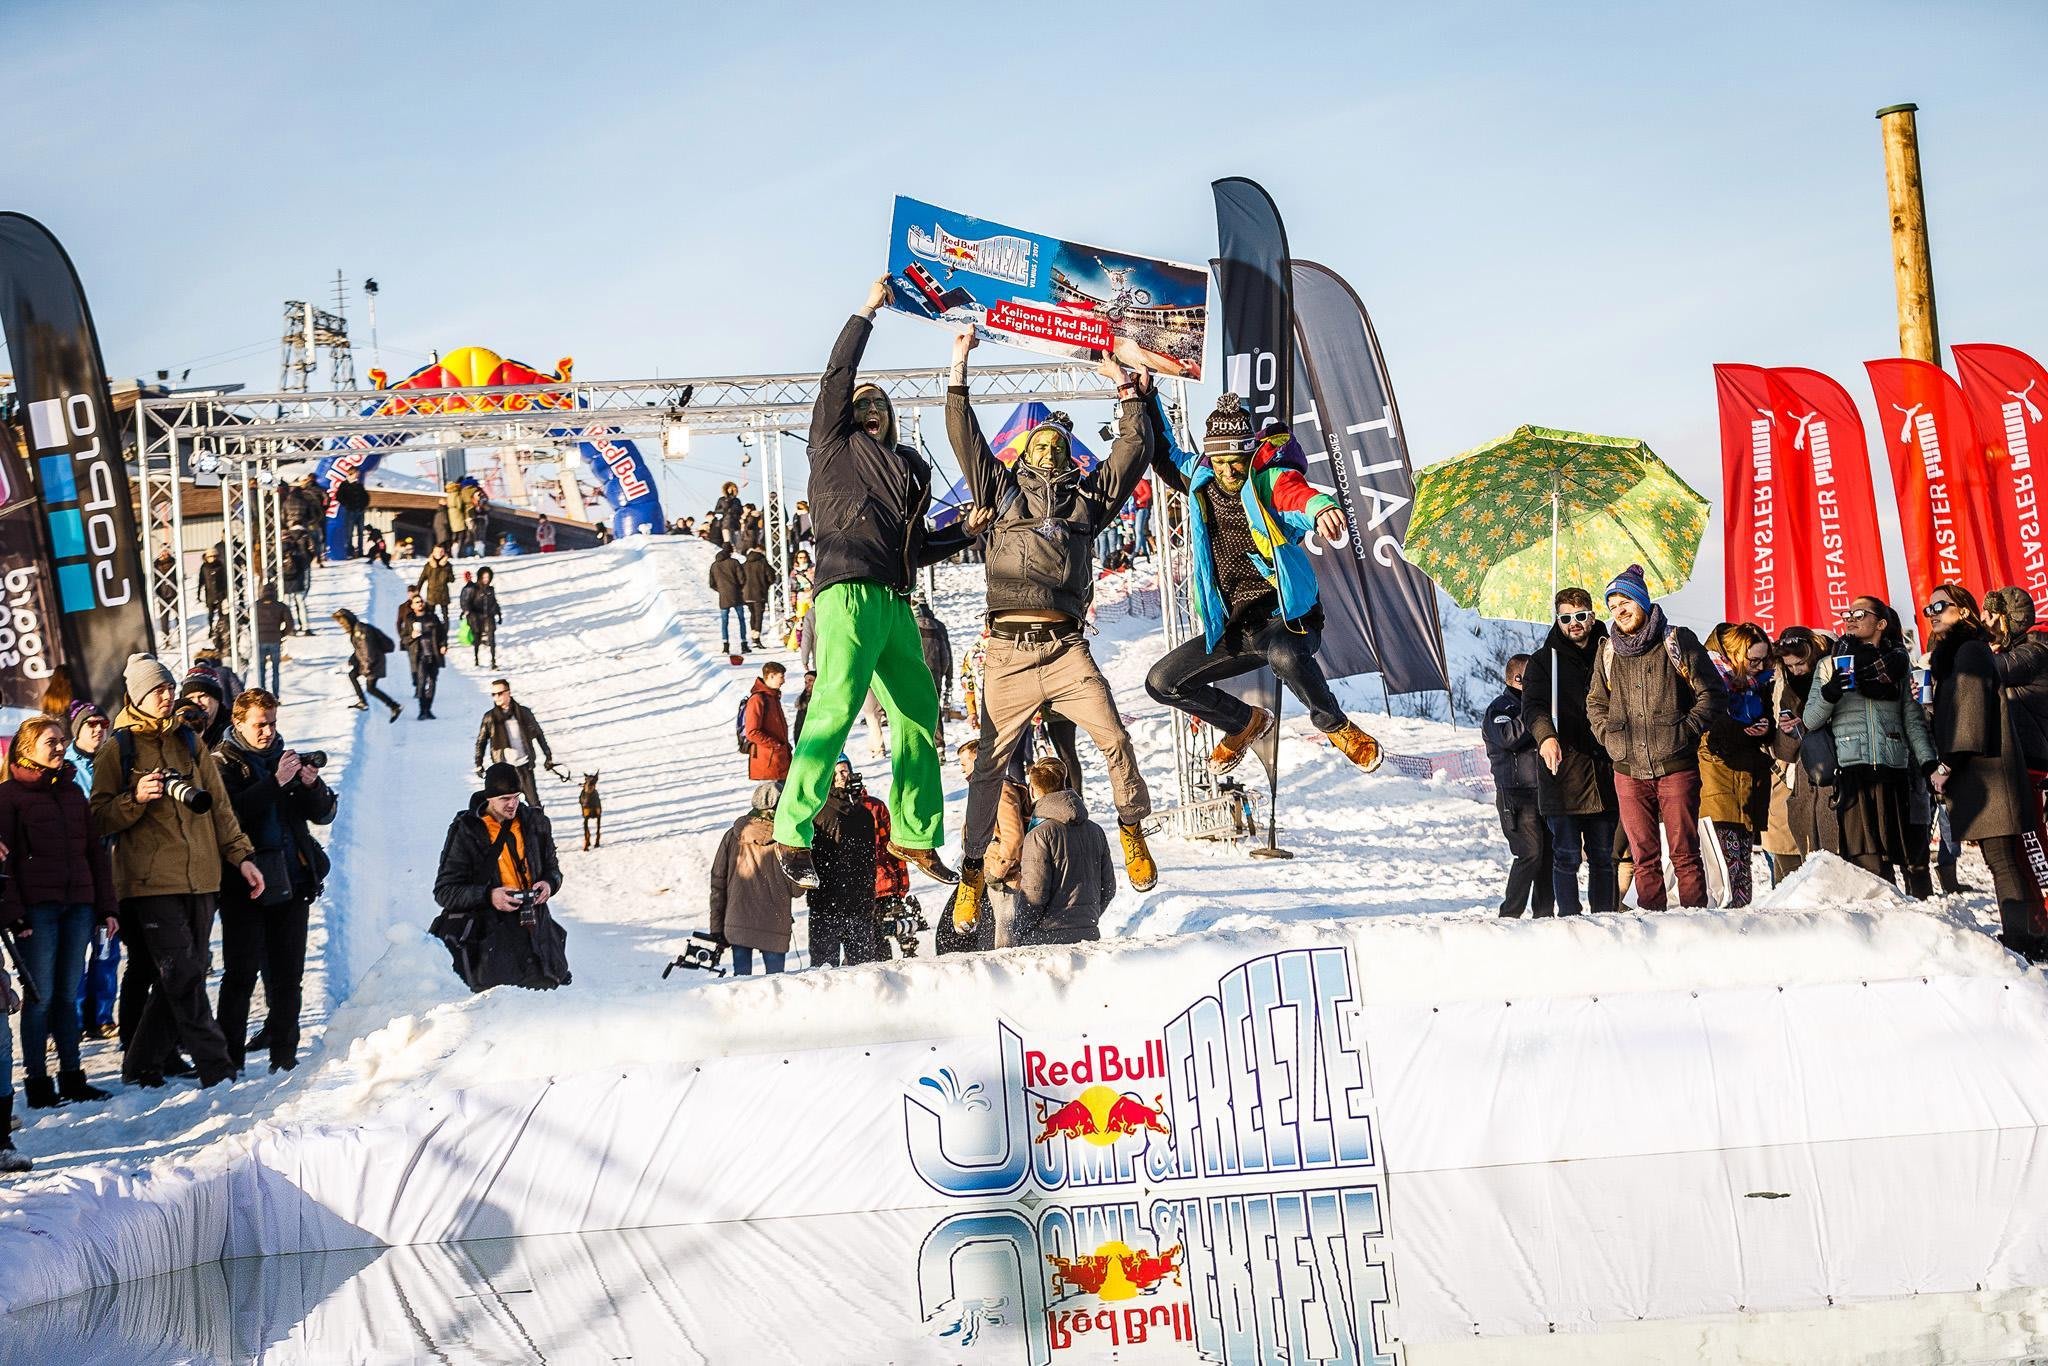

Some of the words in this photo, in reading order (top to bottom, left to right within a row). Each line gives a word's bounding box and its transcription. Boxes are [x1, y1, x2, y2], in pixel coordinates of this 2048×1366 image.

[942, 235, 960, 247] Red
[960, 240, 978, 252] Bull
[1032, 242, 1040, 258] 2017
[991, 313, 1053, 335] X-Fighters
[1001, 304, 1044, 323] Kelionė
[1055, 316, 1077, 329] Red
[1080, 321, 1102, 334] Bull
[1211, 421, 1249, 431] PUMA
[1808, 420, 1835, 486] PUMA
[1914, 412, 1945, 480] PUMA
[615, 459, 647, 497] Bull
[1025, 1045, 1094, 1087] Red
[1098, 1039, 1166, 1082] Bull
